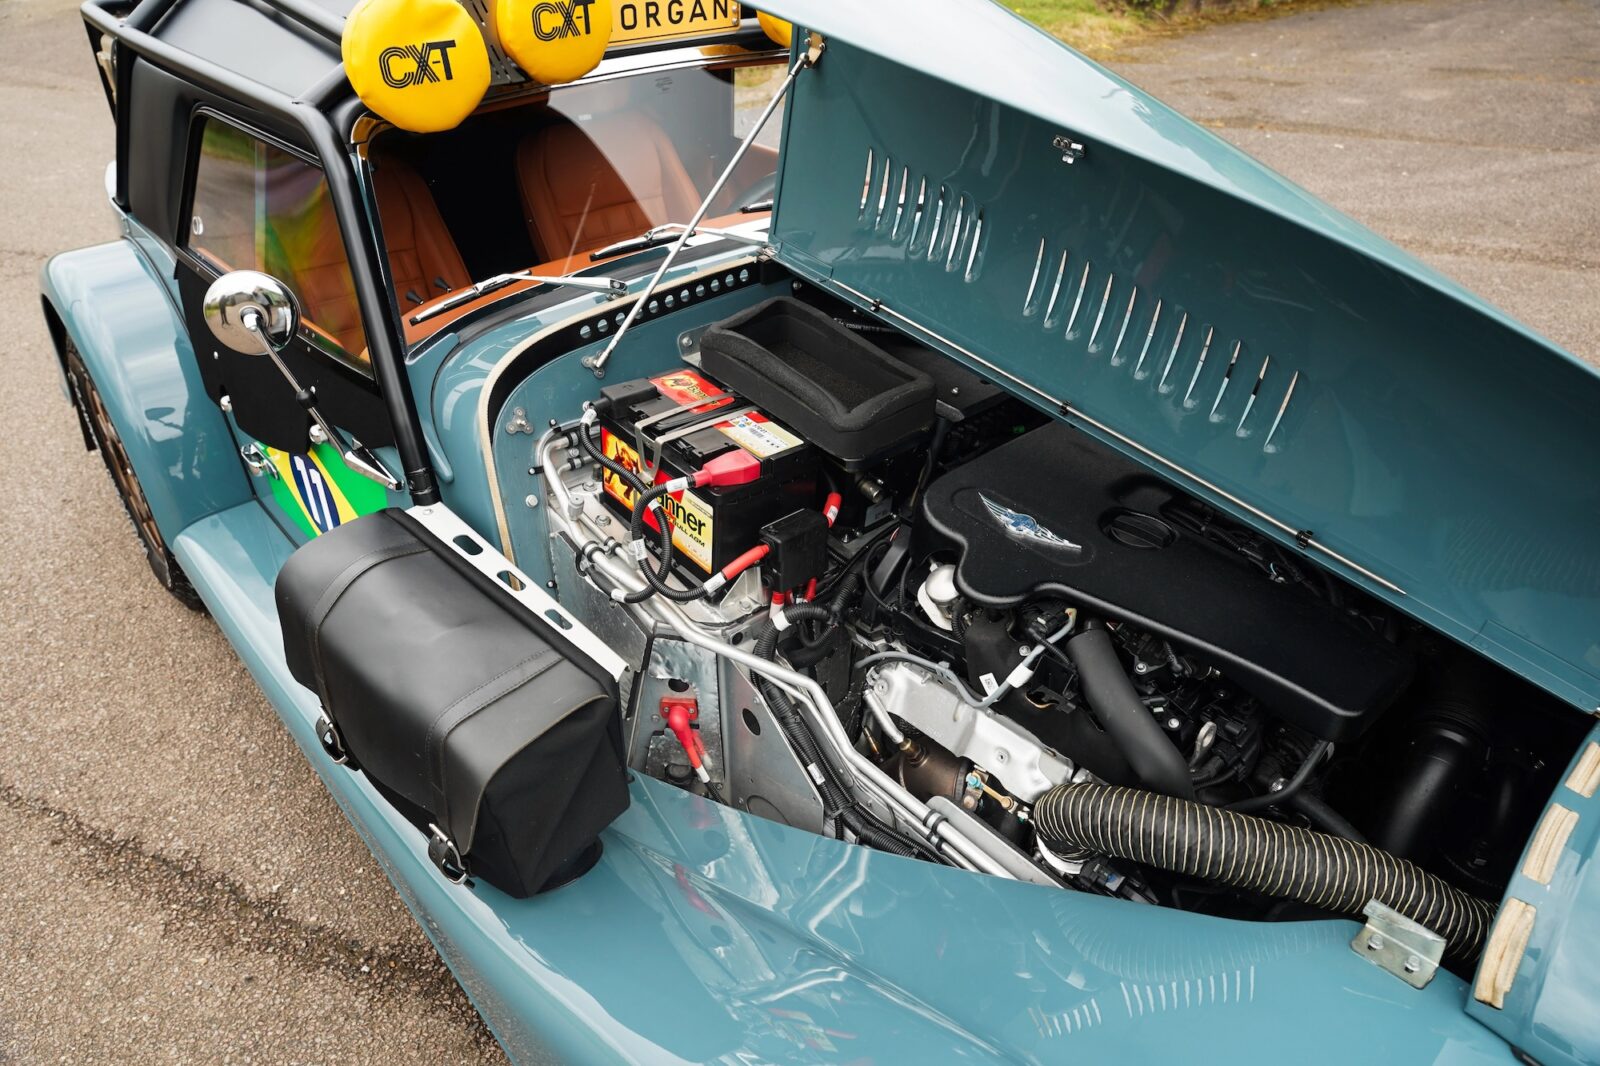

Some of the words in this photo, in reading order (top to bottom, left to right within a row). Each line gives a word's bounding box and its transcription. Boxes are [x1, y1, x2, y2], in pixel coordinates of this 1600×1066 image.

[611, 0, 728, 31] ORGAN
[379, 40, 456, 89] CX-T
[655, 493, 706, 537] anner
